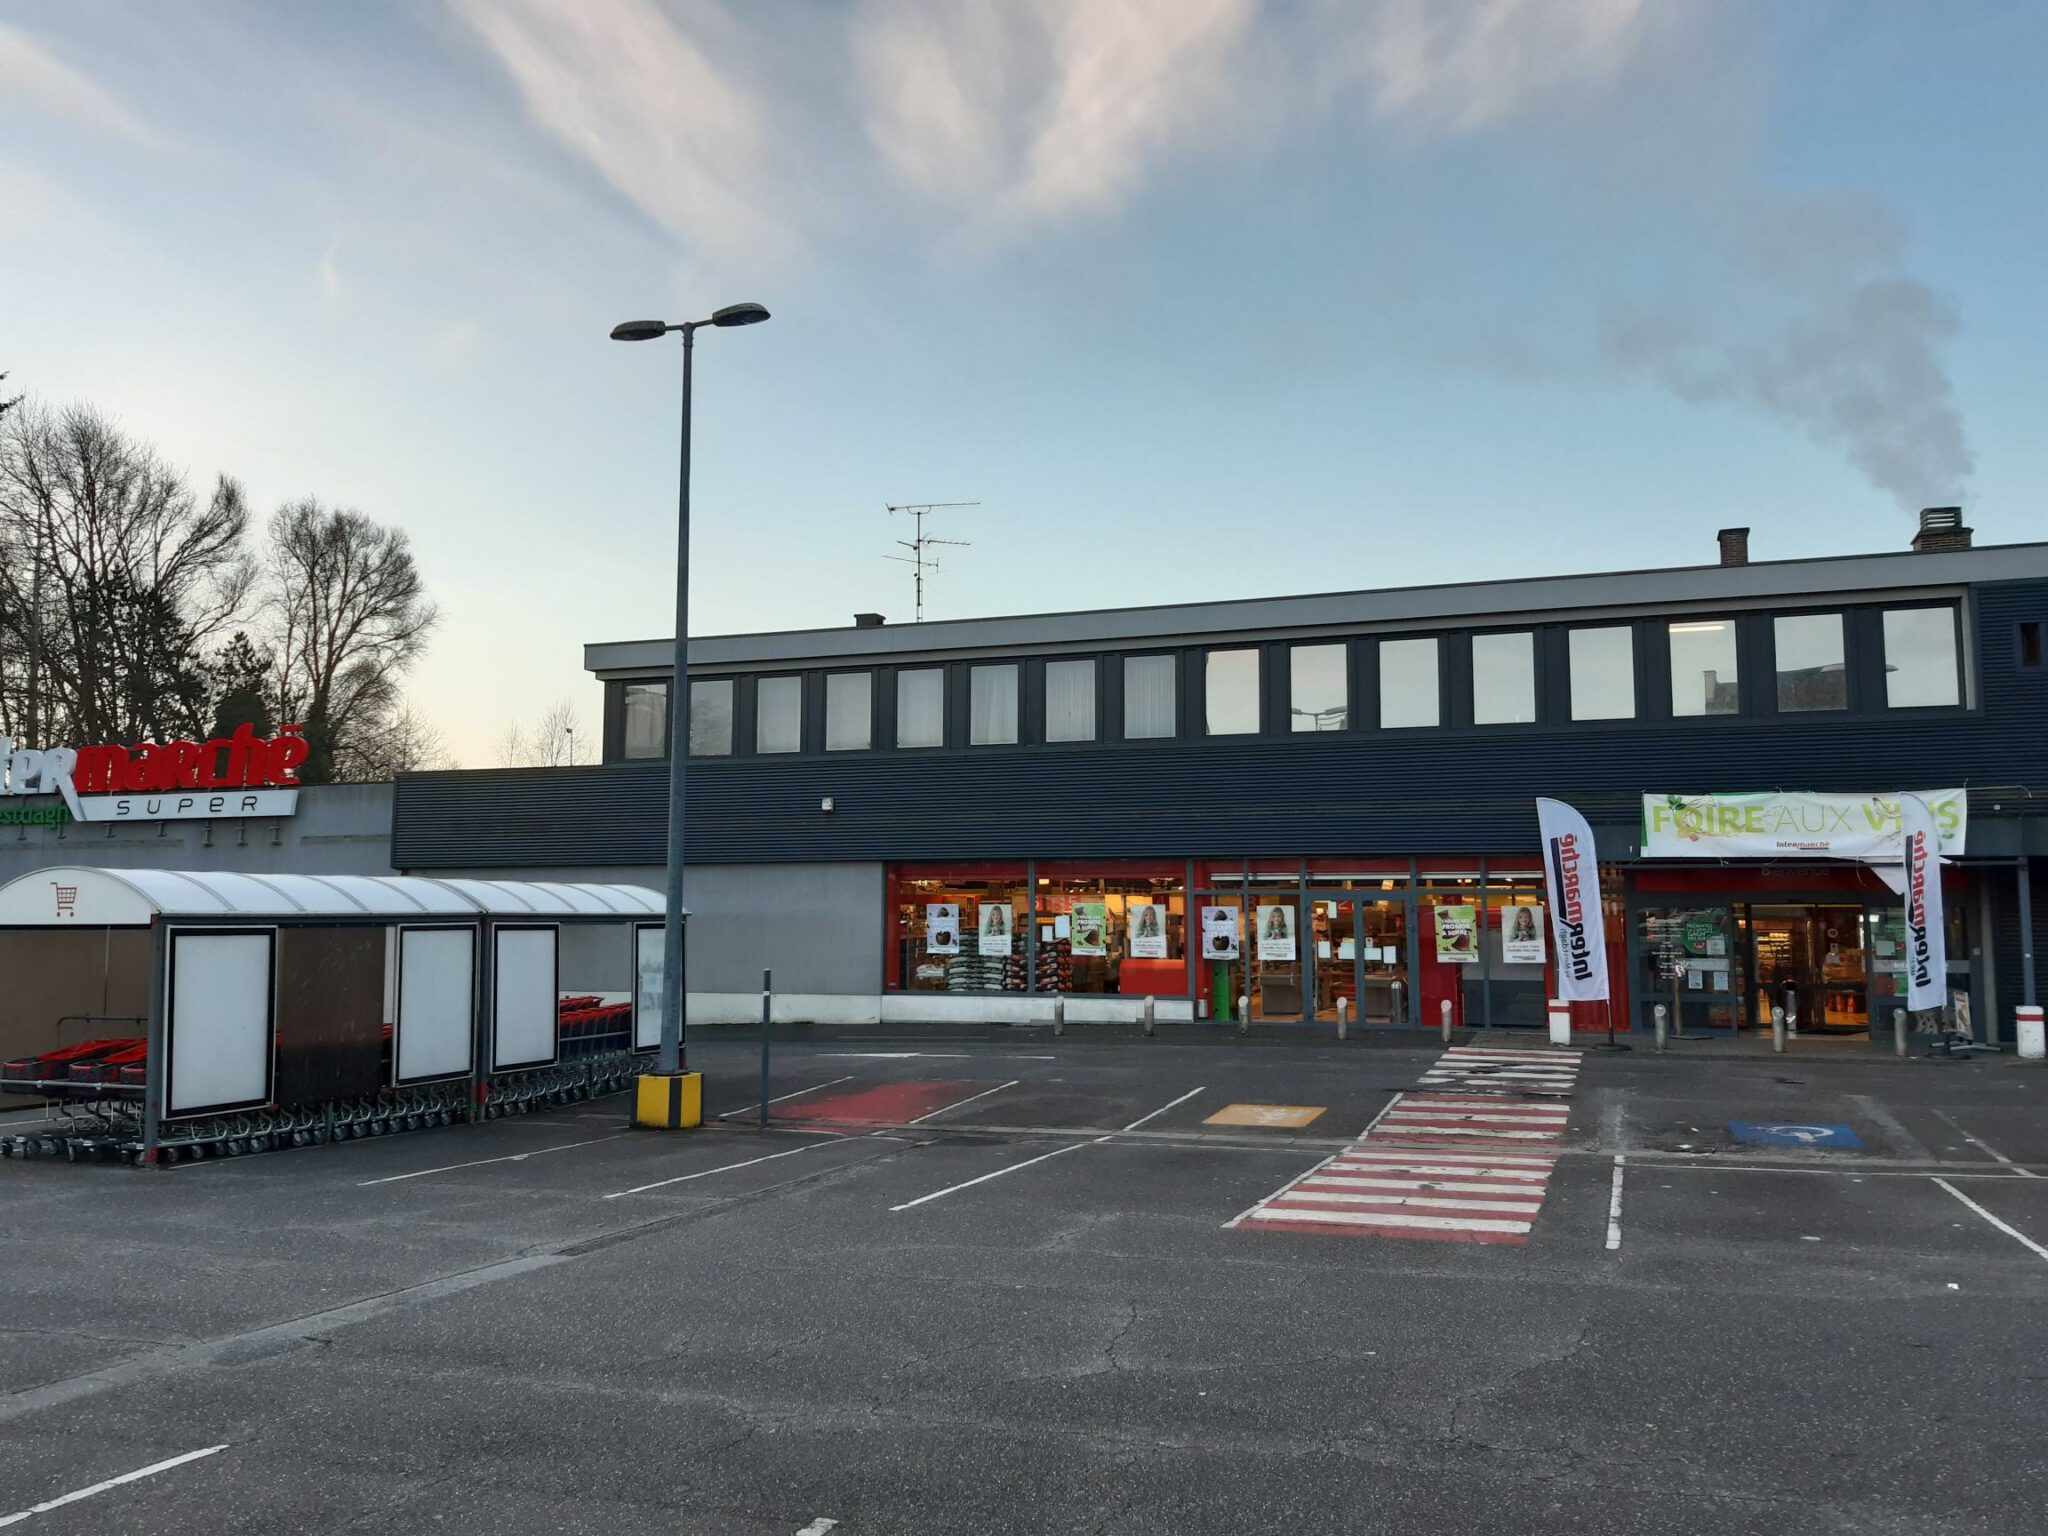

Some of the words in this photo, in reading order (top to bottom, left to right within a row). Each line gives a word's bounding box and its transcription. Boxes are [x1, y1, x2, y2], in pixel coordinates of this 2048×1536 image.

[117, 796, 258, 816] SUPER
[1652, 805, 1765, 833] FOIRE
[1775, 805, 1854, 833] AUX
[1861, 800, 1960, 833] VIS
